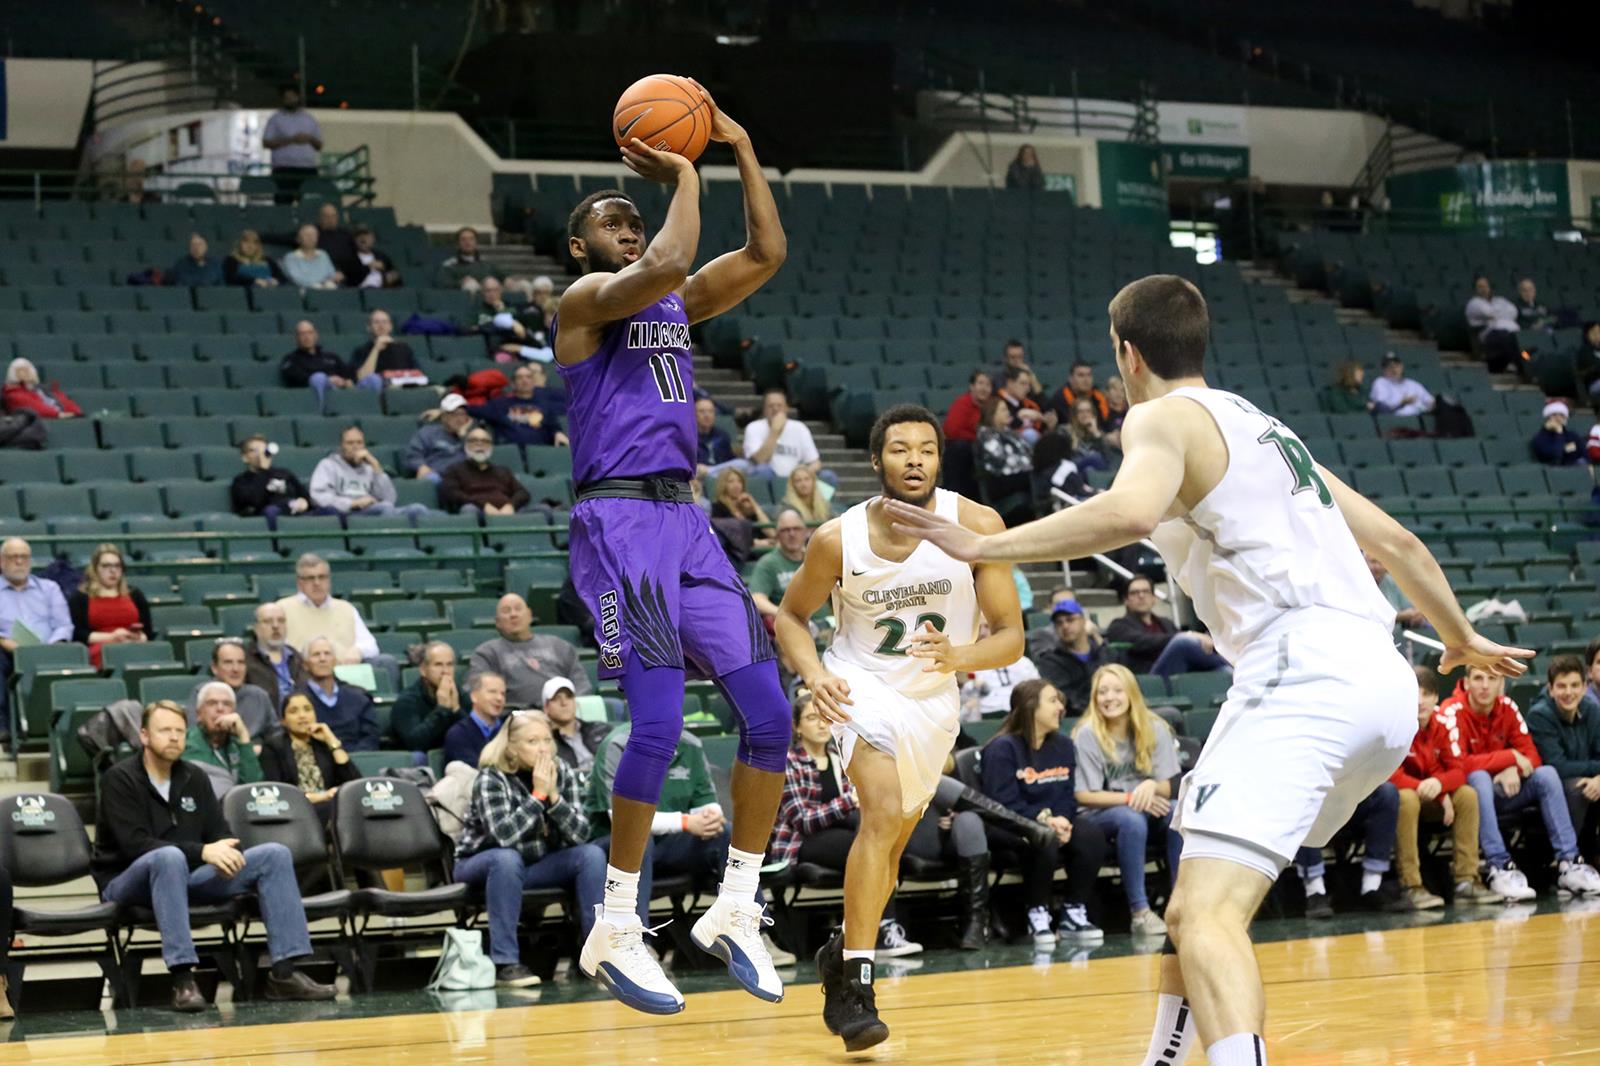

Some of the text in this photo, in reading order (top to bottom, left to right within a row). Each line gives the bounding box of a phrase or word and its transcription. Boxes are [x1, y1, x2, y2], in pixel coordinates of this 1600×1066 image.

[648, 353, 687, 403] 11
[862, 578, 952, 605] CLEVELAND
[886, 596, 927, 611] STATE
